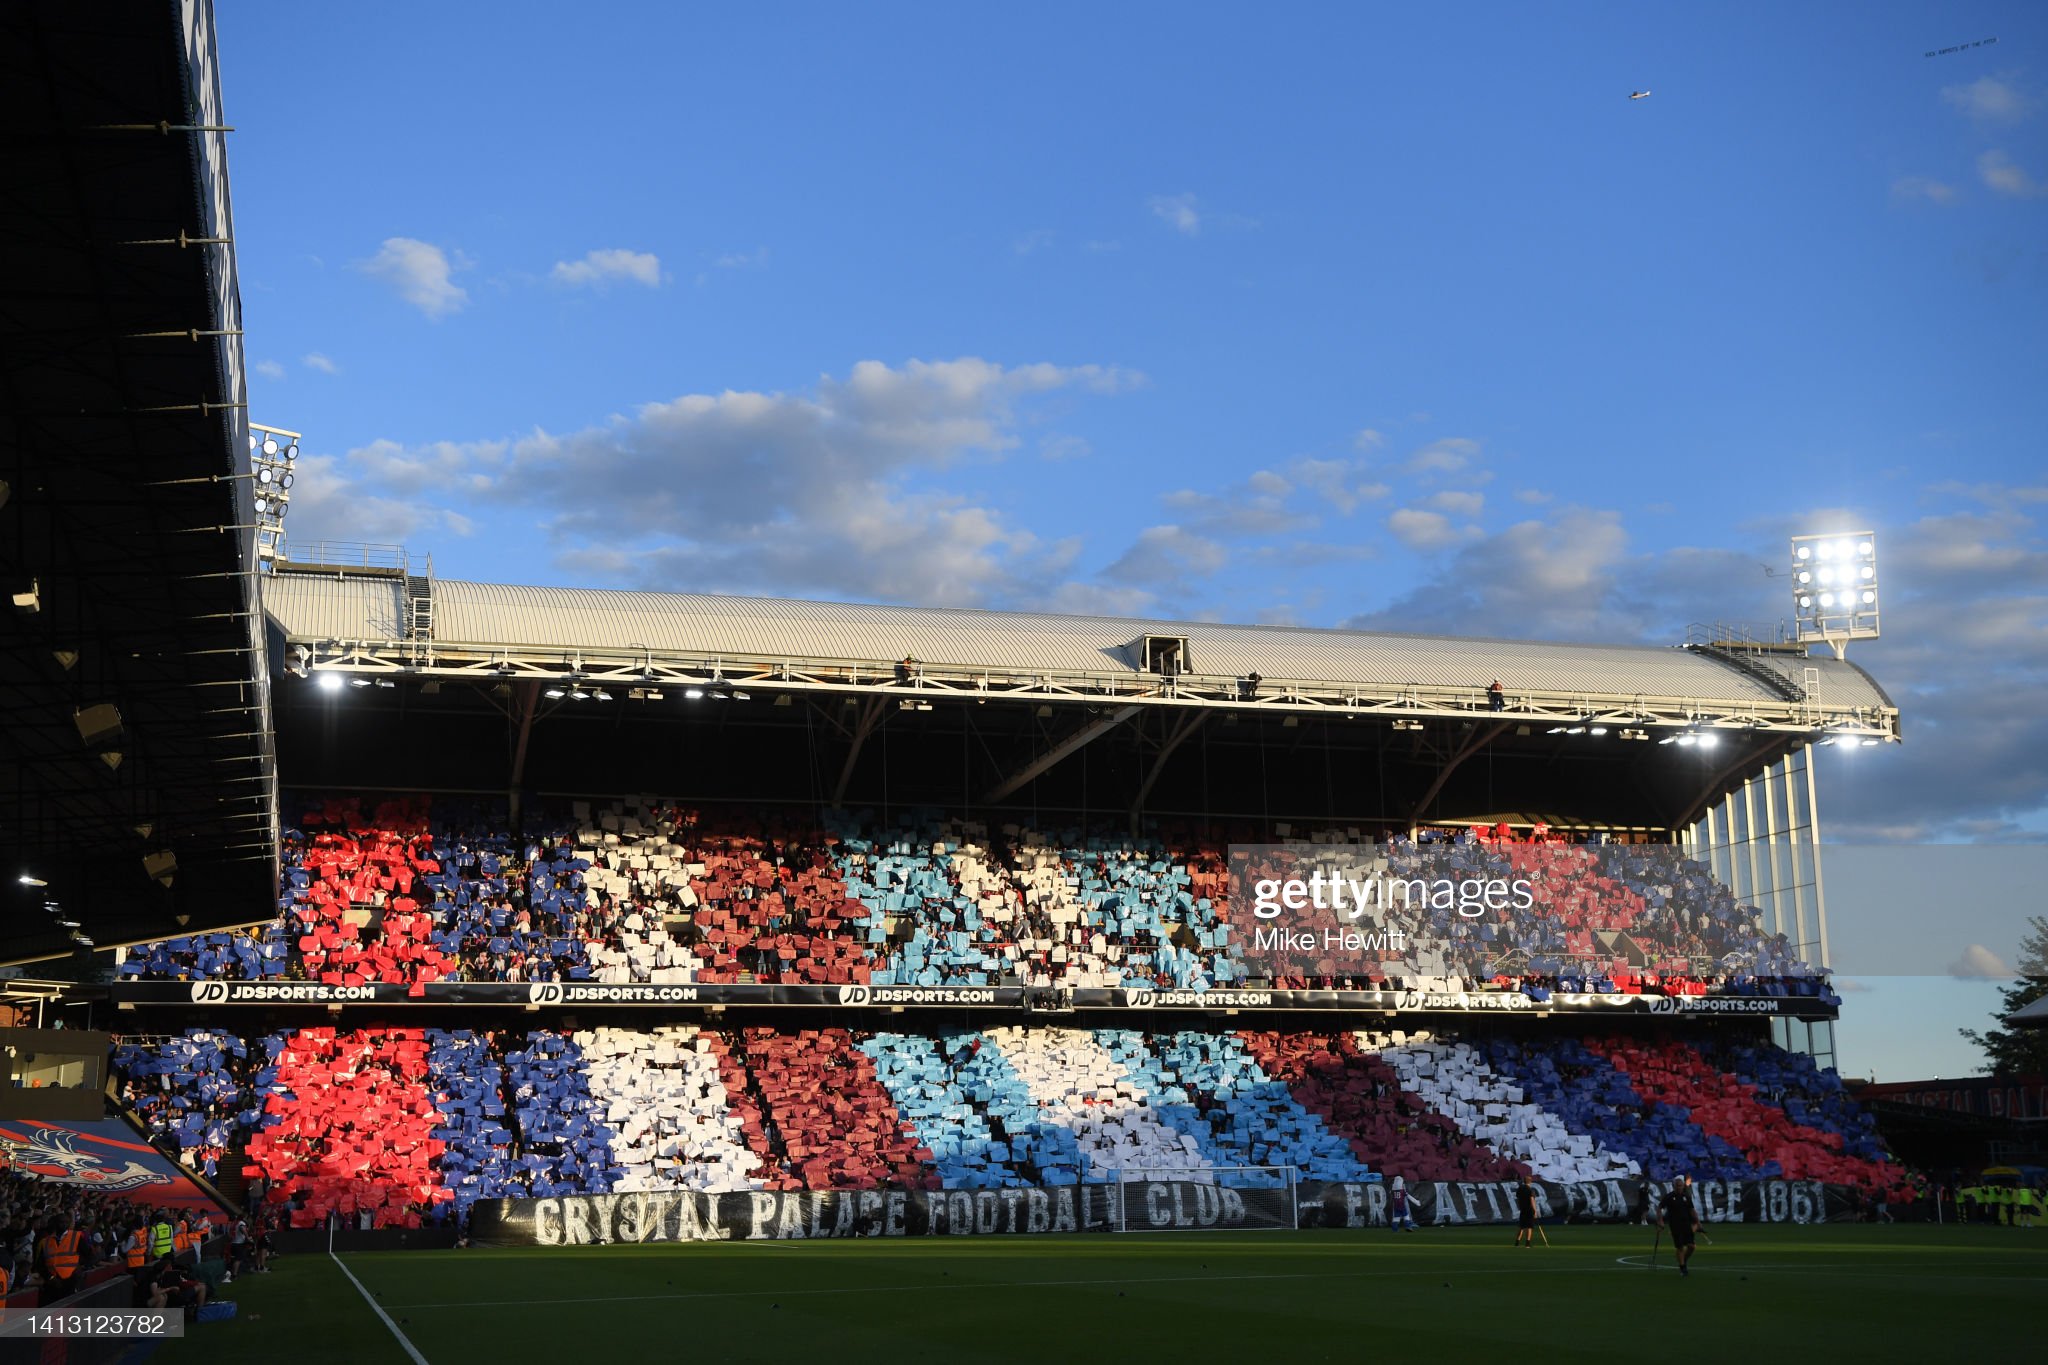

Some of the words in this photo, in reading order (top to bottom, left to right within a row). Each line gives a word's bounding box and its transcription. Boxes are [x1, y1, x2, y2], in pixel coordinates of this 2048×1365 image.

[231, 986, 375, 999] JDSPORTS.COM
[565, 988, 697, 1001] JDSPORTS.COM
[872, 989, 994, 1003] JDSPORTS.COM
[1158, 993, 1272, 1005] JDSPORTS.COM
[1676, 1000, 1778, 1011] JDSPORTS.COM
[534, 1193, 730, 1246] CRYSTAL
[745, 1191, 906, 1240] PALACE
[926, 1184, 1123, 1236] FOOTBALL
[1146, 1182, 1246, 1226] CLUB
[1343, 1184, 1388, 1227] ER
[1432, 1181, 1554, 1225] AFTER
[1758, 1180, 1827, 1224] 1861
